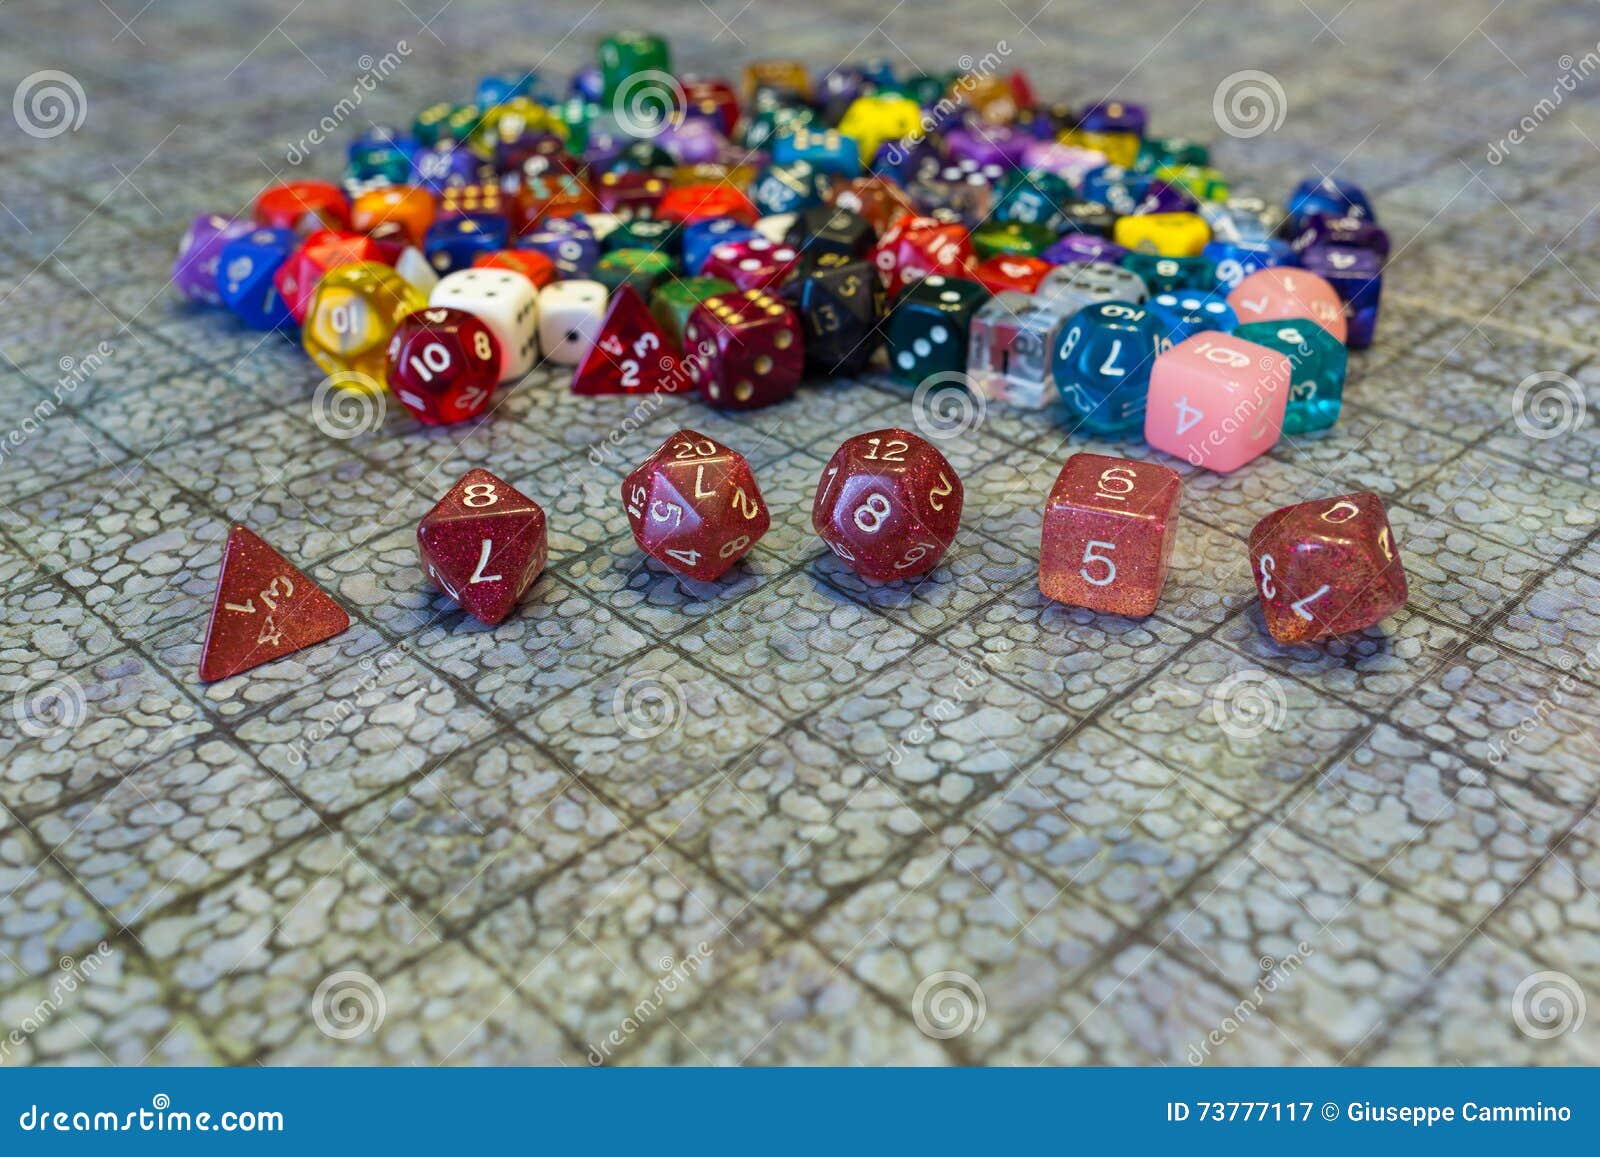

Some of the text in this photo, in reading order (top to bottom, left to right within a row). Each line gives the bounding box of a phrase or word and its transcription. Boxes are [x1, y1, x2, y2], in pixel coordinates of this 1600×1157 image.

[811, 303, 840, 336] 13
[473, 331, 492, 360] 8
[600, 335, 624, 356] 4
[633, 332, 660, 358] 3
[1060, 327, 1081, 360] 8
[1099, 340, 1126, 377] 7
[410, 342, 451, 383] 10
[620, 360, 640, 388] 2
[455, 386, 488, 412] 12
[1174, 394, 1204, 436] 4
[673, 440, 718, 459] 20
[864, 438, 908, 461] 12
[463, 483, 499, 508] 8
[695, 464, 717, 499] 7
[929, 471, 953, 511] 2
[627, 485, 647, 519] 15
[651, 499, 682, 527] 5
[731, 487, 759, 520] 2
[853, 492, 892, 533] 8
[1320, 500, 1360, 524] 0
[469, 538, 503, 585] 7
[665, 548, 702, 567] 4
[719, 535, 750, 559] 8
[1079, 540, 1117, 587] 5
[1259, 552, 1277, 600] 3
[225, 598, 257, 613] 1
[259, 577, 294, 610] 3
[1291, 583, 1331, 622] 7
[256, 615, 283, 647] 4
